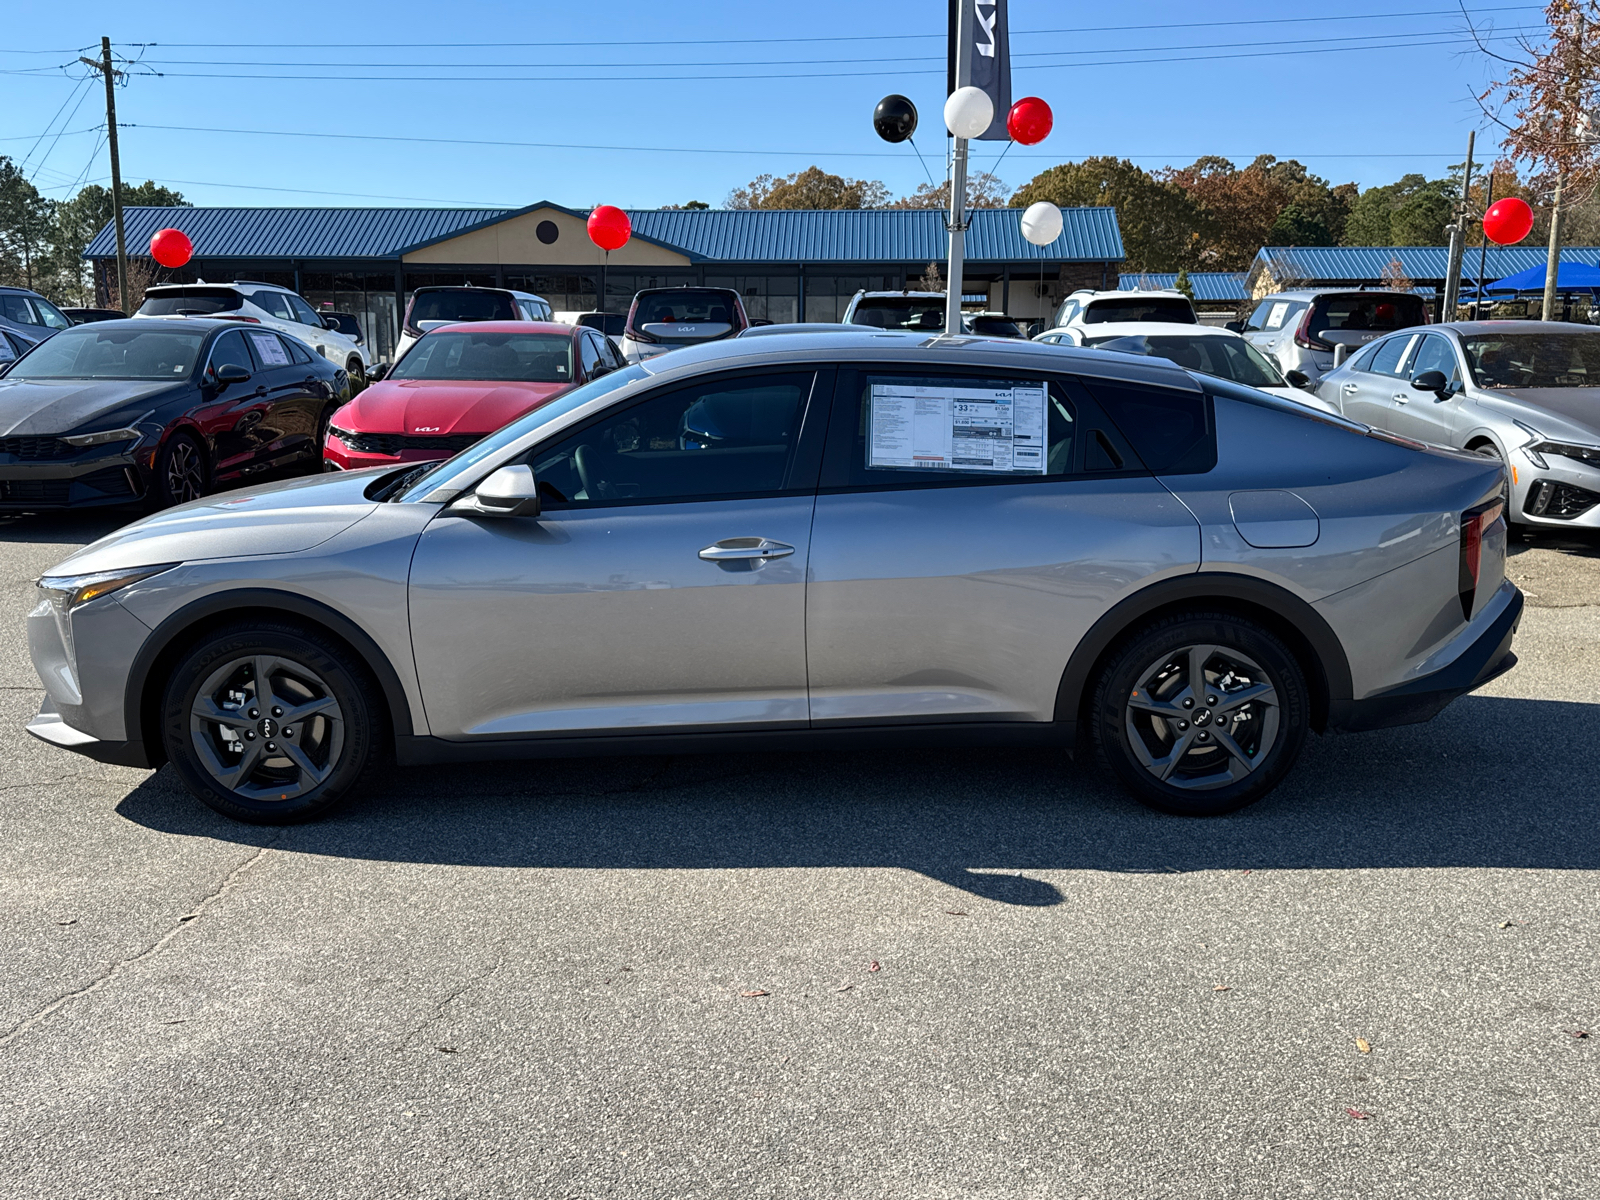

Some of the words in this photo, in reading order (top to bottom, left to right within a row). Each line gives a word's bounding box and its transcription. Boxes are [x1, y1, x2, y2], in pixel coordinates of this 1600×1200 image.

[958, 404, 969, 412] 33
[191, 640, 243, 674] SOLUS
[1279, 667, 1301, 727] KUMHO
[1193, 709, 1211, 726] KIA
[202, 788, 261, 818] KUMHO
